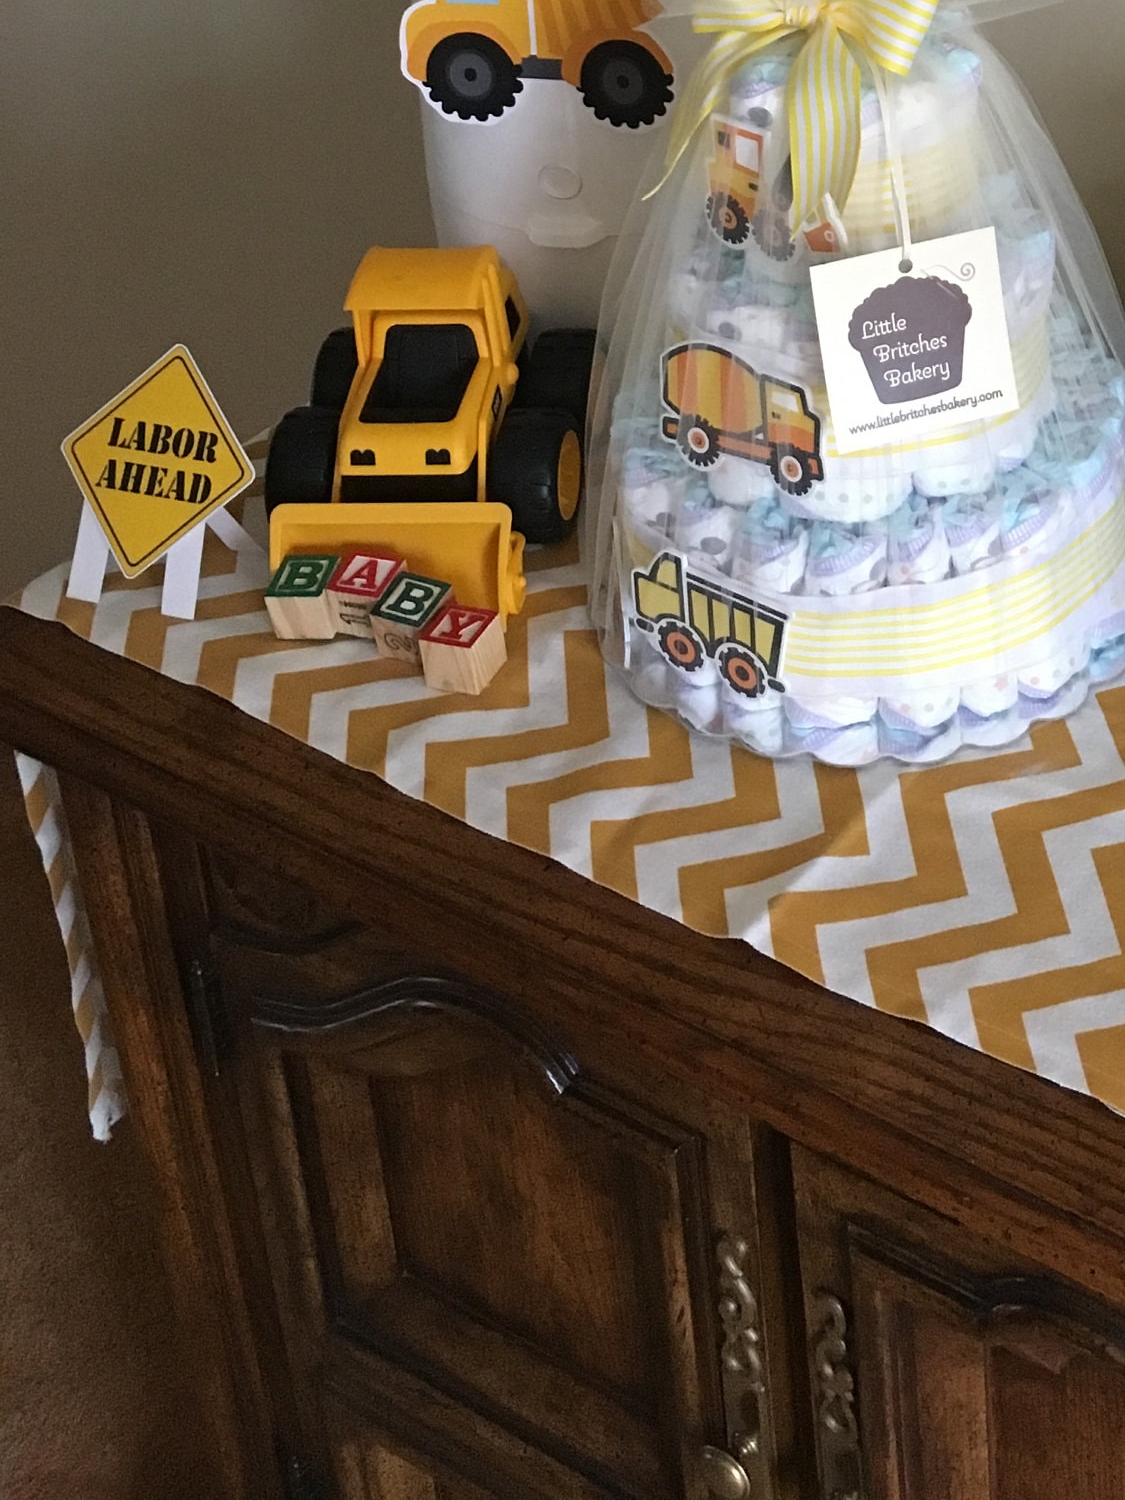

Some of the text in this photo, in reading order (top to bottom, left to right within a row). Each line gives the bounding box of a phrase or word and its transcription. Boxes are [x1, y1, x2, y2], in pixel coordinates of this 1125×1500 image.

[862, 312, 907, 340] Little
[873, 333, 948, 363] Britches
[884, 362, 950, 388] Bakery
[849, 389, 1003, 435] www.littlebritchesbakery.com
[107, 416, 219, 464] LABOR
[96, 458, 212, 506] AHEAD
